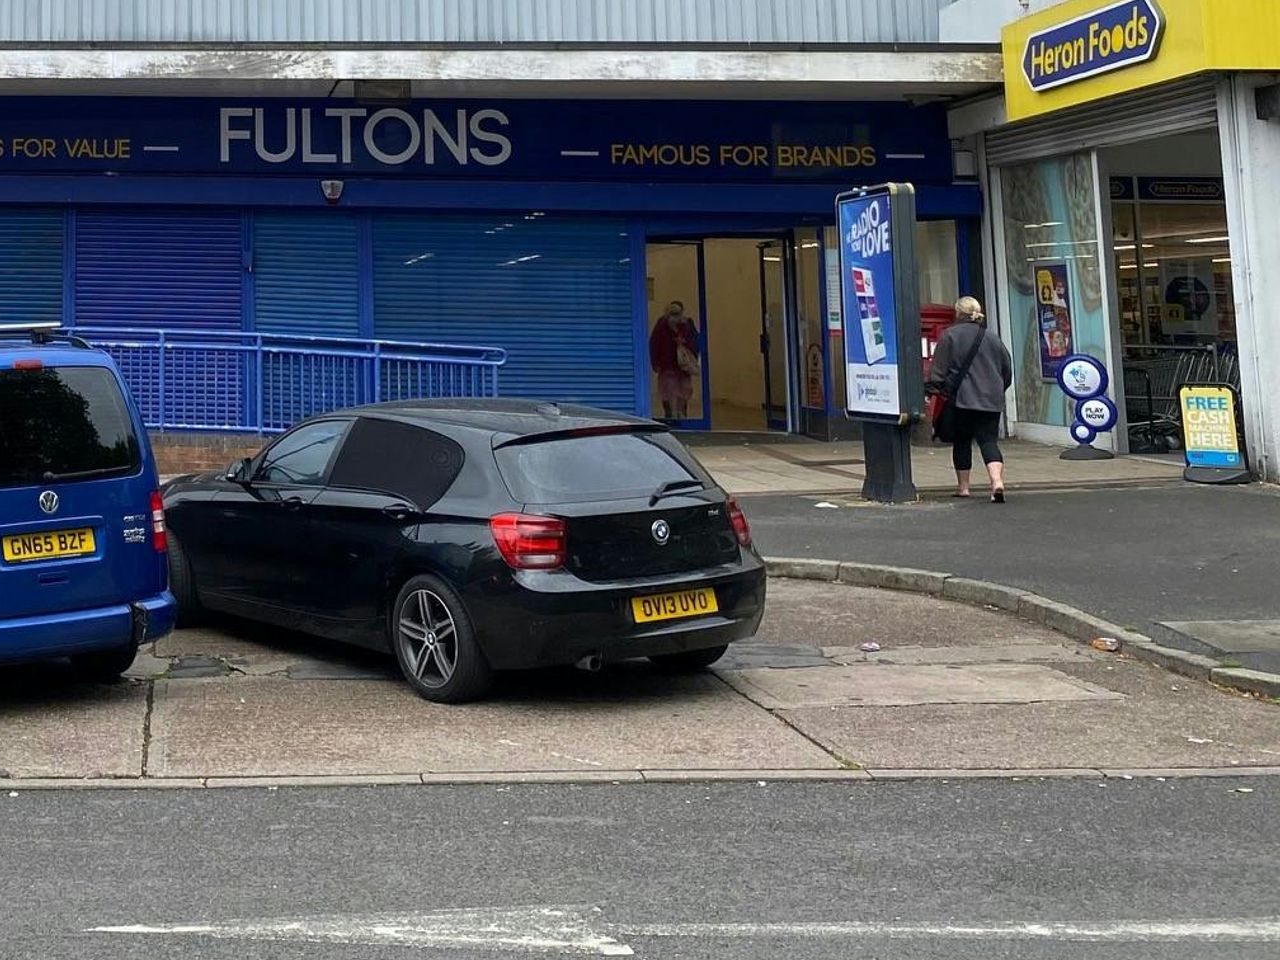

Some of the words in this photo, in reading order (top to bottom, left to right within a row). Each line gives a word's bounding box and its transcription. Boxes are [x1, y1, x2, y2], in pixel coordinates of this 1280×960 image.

[1031, 37, 1084, 80] Heron
[1088, 6, 1149, 61] Foods
[12, 138, 56, 159] FOR
[64, 139, 131, 159] VALUE
[219, 106, 513, 167] FULTONS
[610, 143, 710, 168] FAMOUS
[720, 144, 770, 168] FOR
[777, 144, 877, 168] BRANDS
[851, 200, 880, 242] RADIO
[862, 221, 890, 259] LOVE
[1086, 412, 1105, 420] NOW
[1186, 397, 1229, 410] FREE
[1187, 411, 1231, 424] CASH
[1190, 433, 1233, 448] HERE
[11, 535, 55, 556] GN65
[58, 531, 88, 552] BZF
[642, 597, 676, 617] OV13
[678, 592, 709, 612] UYO
